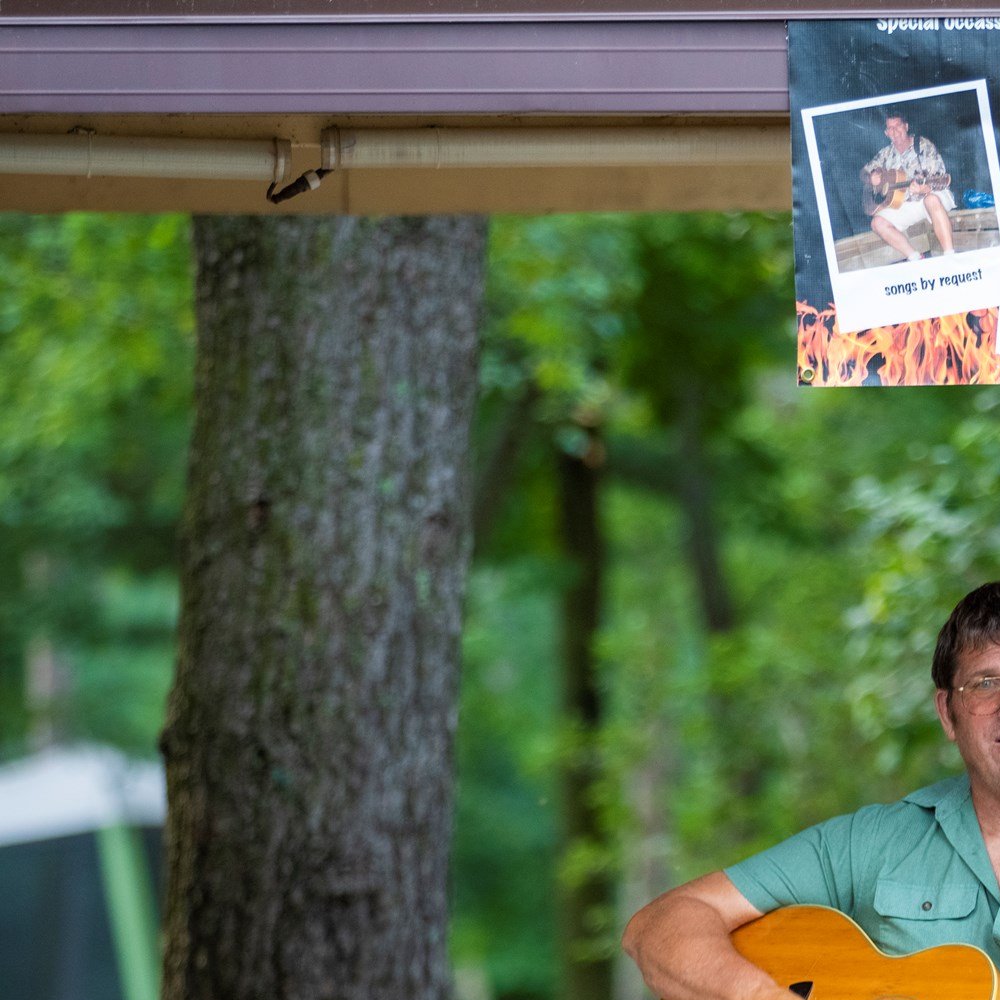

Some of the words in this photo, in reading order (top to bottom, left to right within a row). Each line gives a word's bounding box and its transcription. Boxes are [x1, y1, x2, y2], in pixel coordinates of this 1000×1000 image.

[884, 281, 918, 296] songs
[920, 277, 936, 291] by
[939, 268, 983, 287] request
